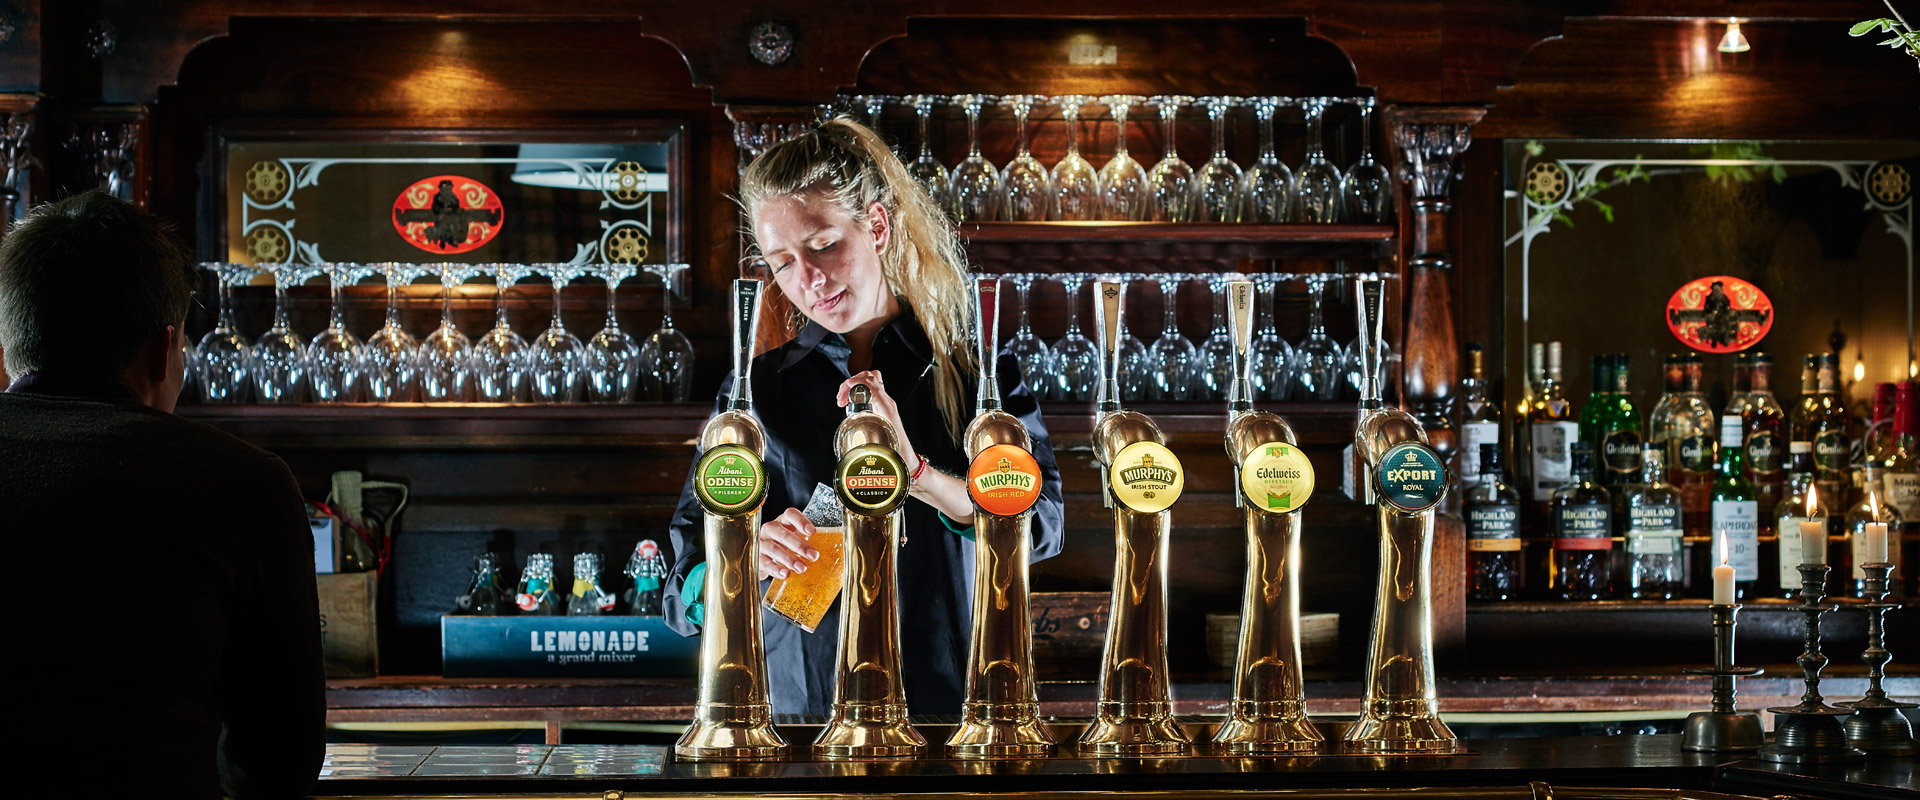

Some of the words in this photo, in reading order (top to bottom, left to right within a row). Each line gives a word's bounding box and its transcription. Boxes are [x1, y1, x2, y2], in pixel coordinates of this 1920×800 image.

[716, 466, 744, 475] Albani
[858, 466, 884, 476] Albani
[1124, 468, 1172, 482] MURPHY'S
[1256, 468, 1301, 479] Edelweiss
[1387, 468, 1436, 483] EXPORT
[706, 478, 754, 486] ODENSE
[848, 478, 896, 486] ODENSE
[980, 474, 1030, 489] MURPHY'S
[1471, 510, 1516, 520] HIGHLAND
[1562, 510, 1607, 520] HIGHLAND
[1631, 508, 1675, 518] HIGHLAND
[1482, 520, 1506, 530] PARK
[1574, 520, 1598, 529] PARK
[1642, 518, 1664, 526] PARK
[1735, 544, 1745, 554] 10
[530, 630, 649, 652] LEMONADE
[547, 654, 555, 662] a
[558, 652, 595, 665] grand
[598, 652, 636, 662] mixer
